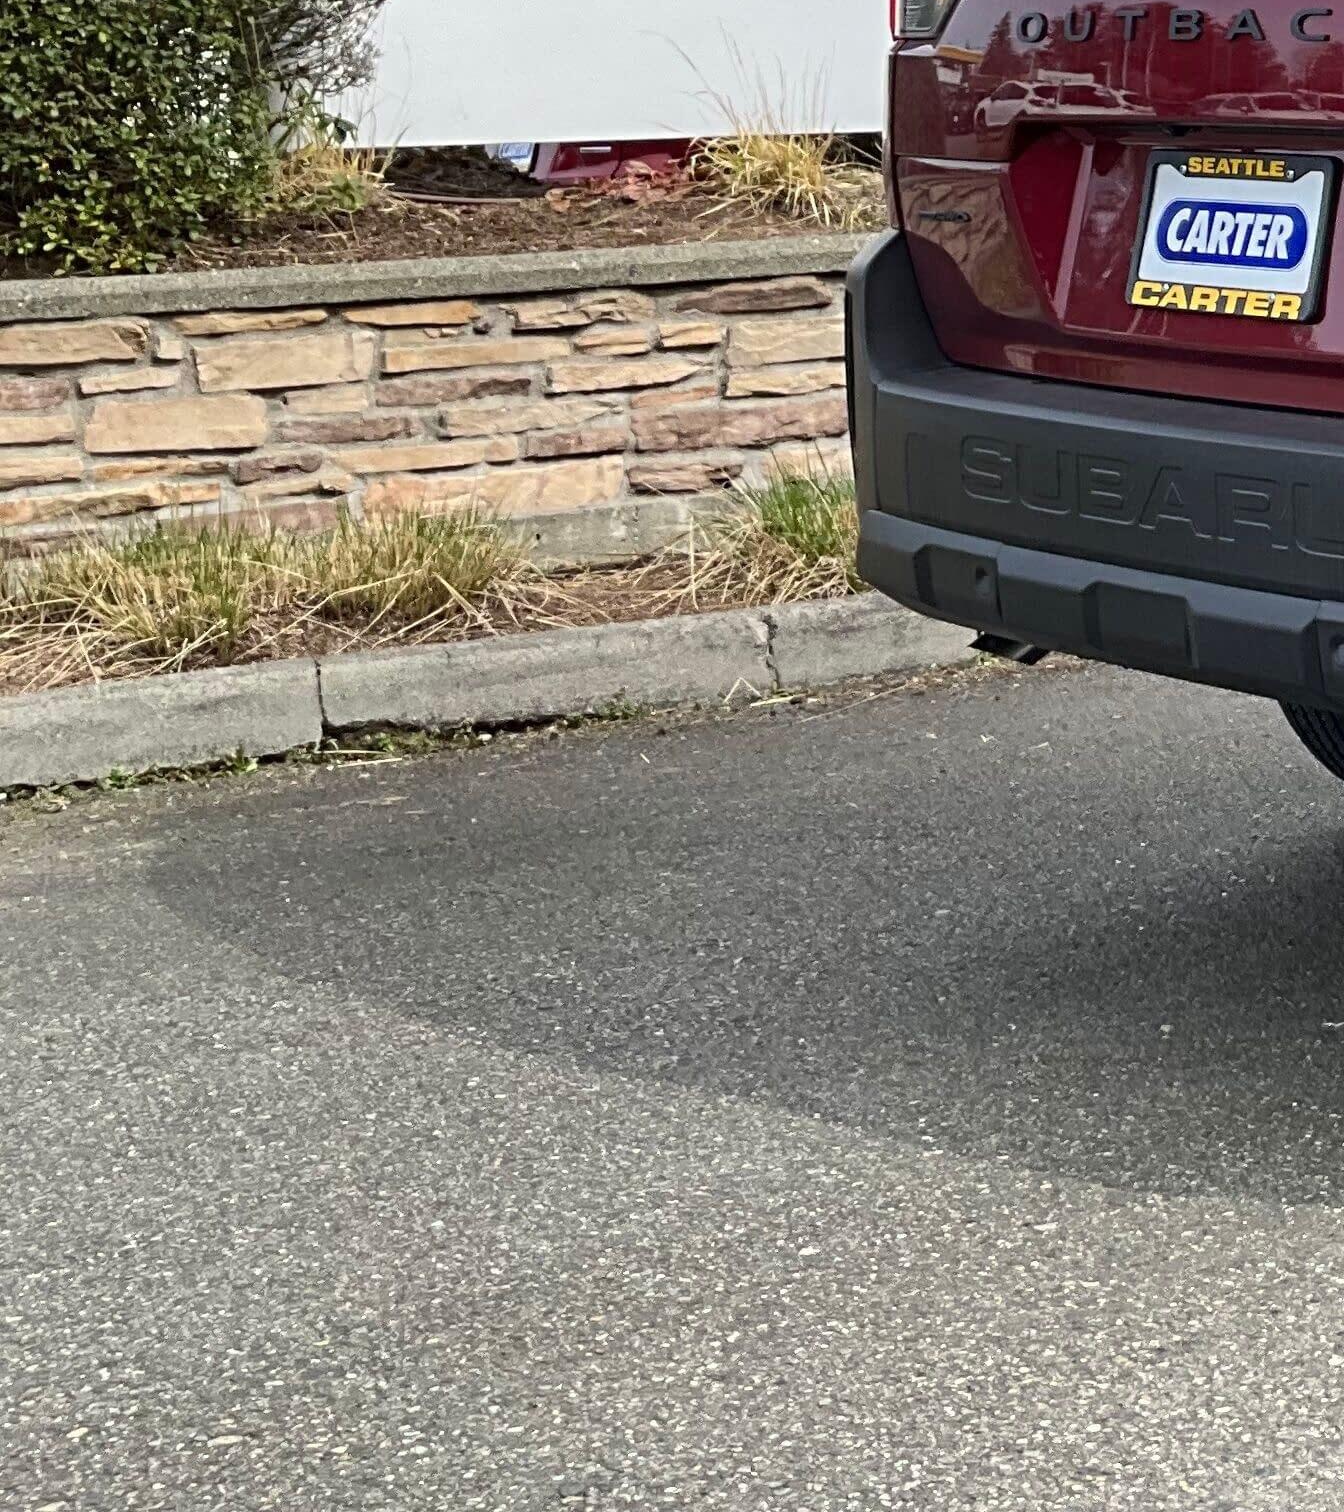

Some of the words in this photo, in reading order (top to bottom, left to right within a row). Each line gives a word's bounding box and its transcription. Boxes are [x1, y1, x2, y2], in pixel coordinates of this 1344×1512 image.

[1187, 155, 1286, 178] SEATTLE
[1166, 206, 1294, 260] CARTER
[1131, 280, 1303, 320] CARTER
